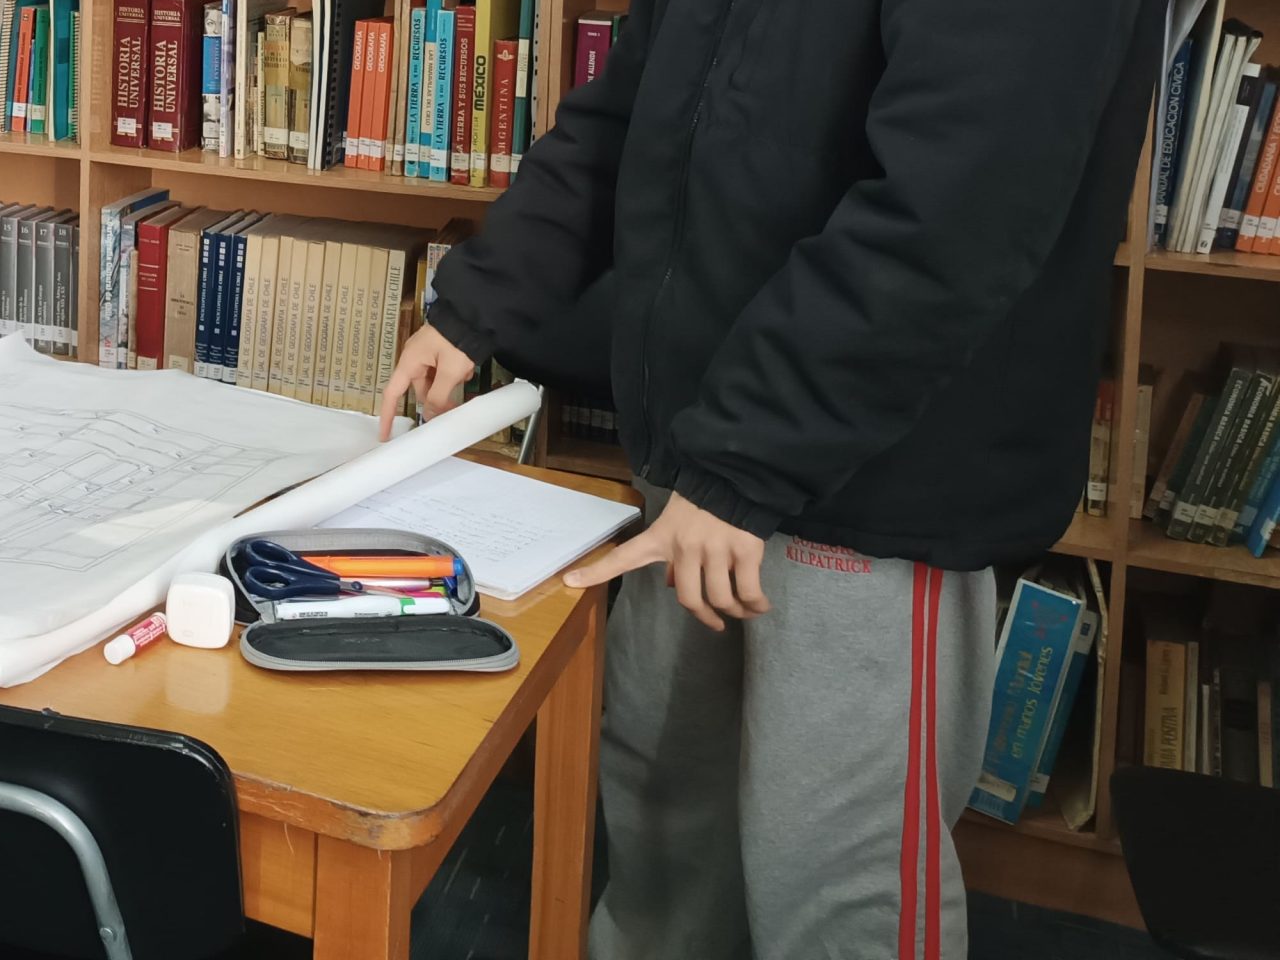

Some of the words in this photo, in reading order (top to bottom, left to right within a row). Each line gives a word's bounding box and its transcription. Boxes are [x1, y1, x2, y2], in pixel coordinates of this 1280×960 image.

[353, 31, 363, 70] GEOGRAFÍA
[366, 32, 375, 71] GEOGRAFÍA
[378, 33, 387, 72] GEOGRAFÍA
[413, 18, 421, 60] RECURSOS
[117, 37, 131, 107] HISTORIA
[130, 37, 141, 109] UNIVERSAL
[439, 38, 447, 81] RECURSOS
[459, 38, 468, 81] RECURSOS
[153, 40, 167, 111] HISTORIA
[166, 41, 178, 112] UNIVERSAL
[473, 55, 486, 112] MÉXICO
[410, 82, 418, 110] TIERRA
[458, 83, 466, 99] SUS
[409, 112, 417, 123] LA
[436, 102, 445, 131] TIERRA
[456, 110, 465, 140] TIERRA
[498, 79, 509, 155] ARGENTINA
[436, 133, 444, 144] LA
[1160, 157, 1171, 167] DE
[1156, 170, 1169, 203] ANUAL
[262, 278, 270, 297] CHILE
[389, 265, 400, 291] CHILE
[261, 299, 269, 308] DE
[309, 284, 317, 302] CHILE
[371, 290, 380, 308] CHILE
[389, 292, 398, 301] de
[307, 305, 314, 313] DE
[370, 311, 378, 320] DE
[259, 310, 268, 346] GEOGRAFIA
[305, 316, 314, 352] GEOGRAFIA
[366, 322, 376, 359] GEOGRAFIA
[383, 303, 397, 350] GEOGRAFIA
[258, 349, 265, 358] DE
[304, 355, 310, 363] DE
[366, 362, 373, 370] DE
[383, 350, 392, 360] de
[786, 544, 872, 574] KILPATRICK
